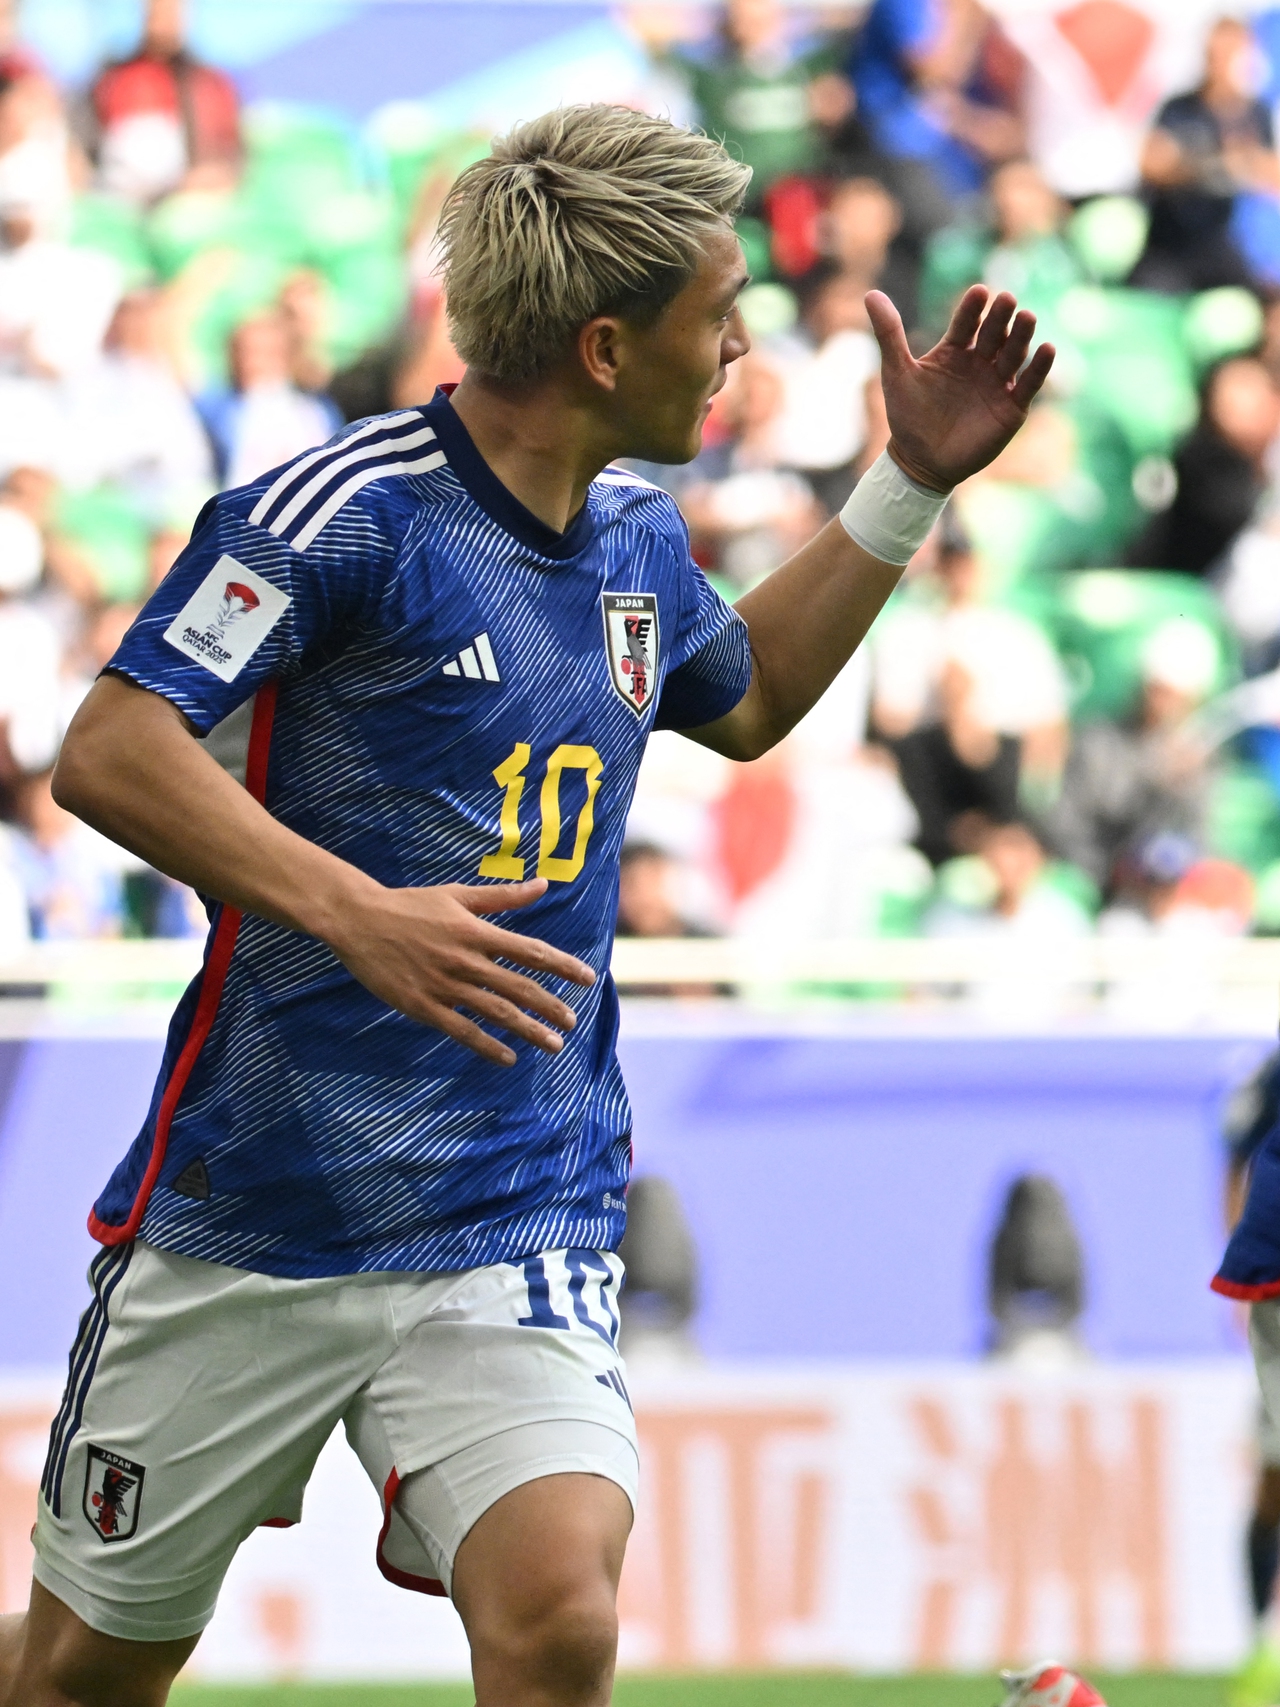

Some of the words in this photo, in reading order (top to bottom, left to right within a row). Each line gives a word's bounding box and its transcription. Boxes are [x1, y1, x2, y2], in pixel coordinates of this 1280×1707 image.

[615, 598, 644, 608] JAPAN
[182, 634, 206, 653] QATAR
[183, 626, 213, 648] ASIAN
[212, 645, 232, 660] CUP
[204, 631, 220, 643] AFC
[478, 742, 604, 883] 10
[502, 1248, 620, 1357] 10
[101, 1451, 132, 1471] JAPAN
